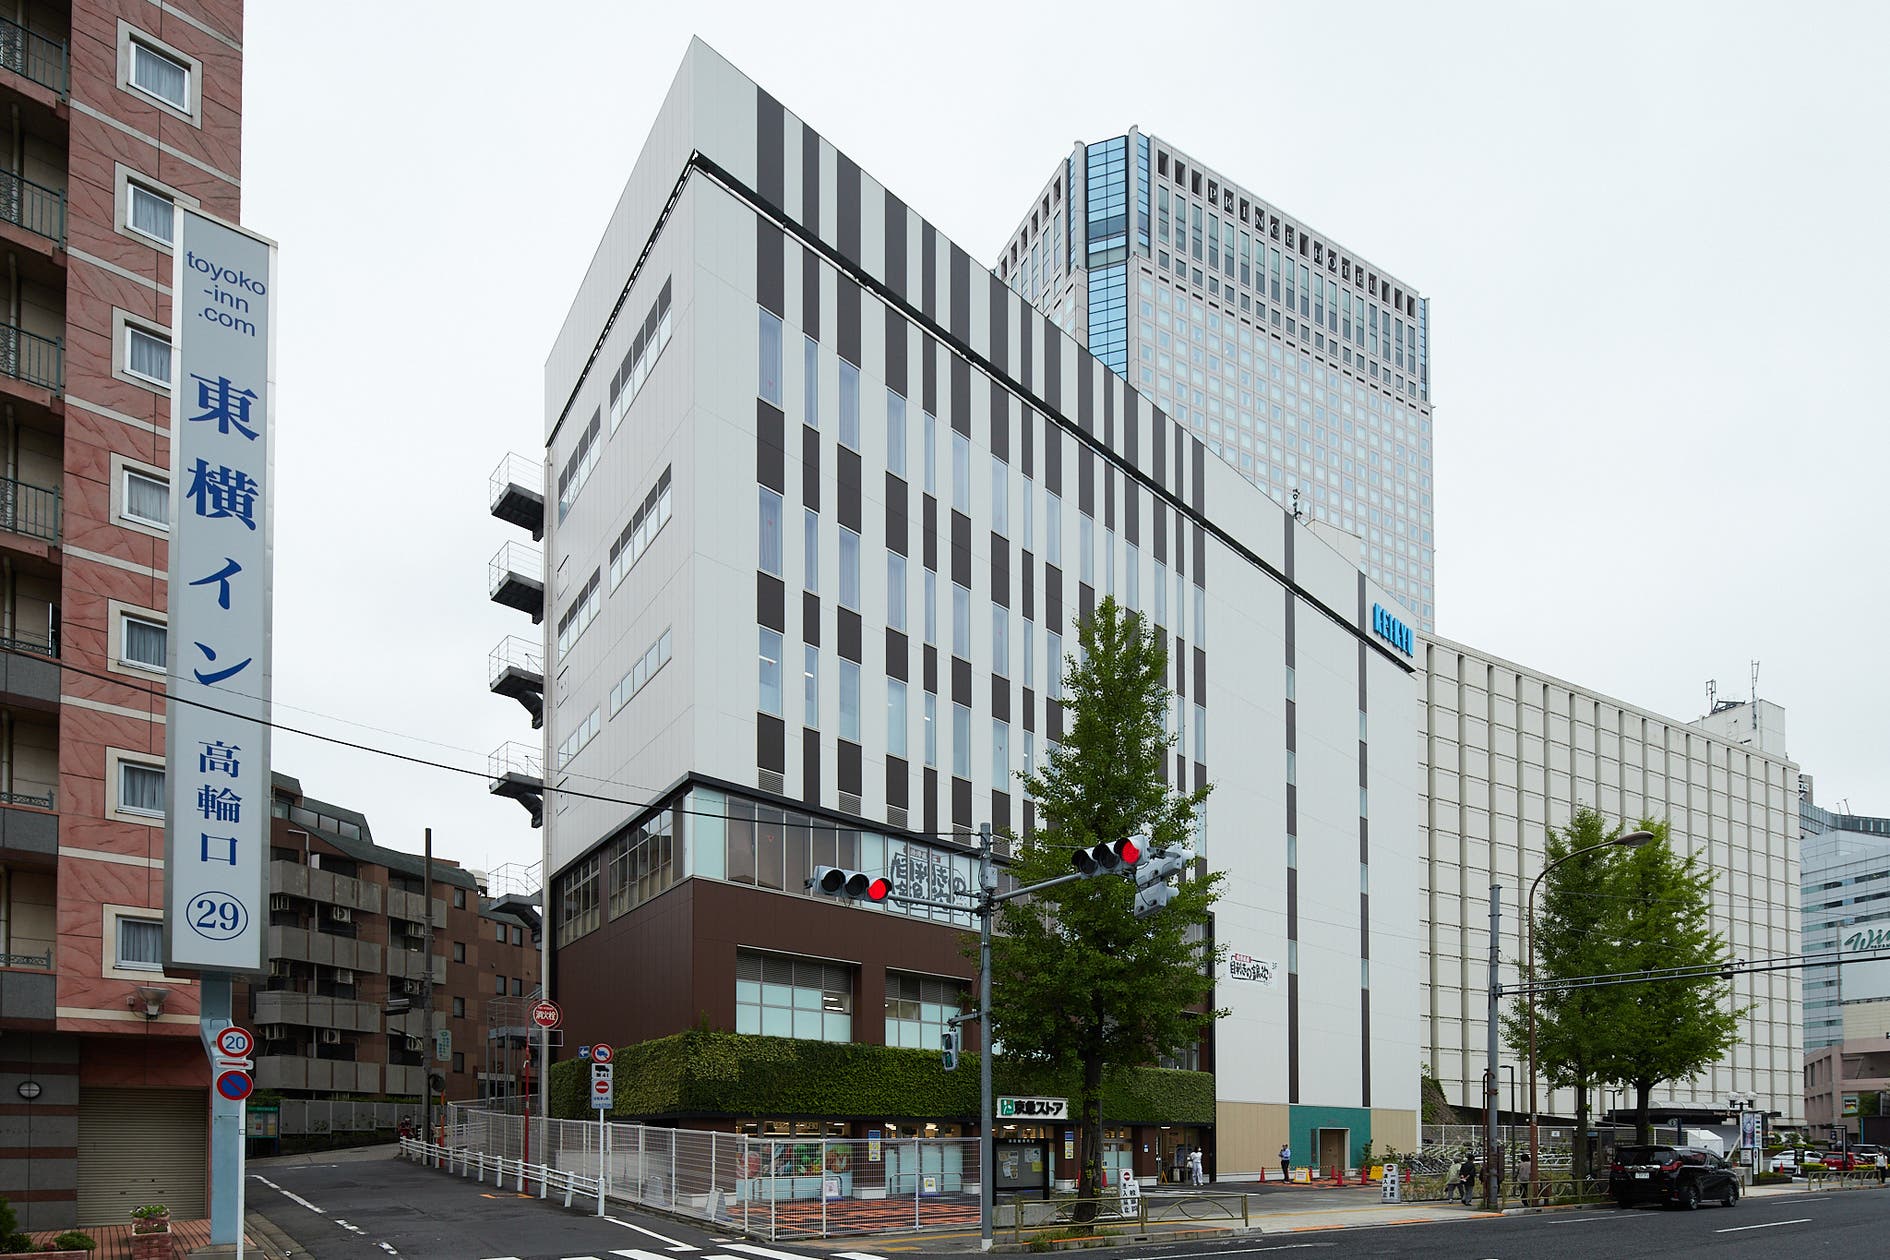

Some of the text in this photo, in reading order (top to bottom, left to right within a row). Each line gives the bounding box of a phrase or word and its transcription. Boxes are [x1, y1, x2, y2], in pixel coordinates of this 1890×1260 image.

[1210, 187, 1375, 292] PRINCE HOTEL
[187, 250, 266, 296] toyoko
[203, 284, 249, 314] -inn
[198, 306, 256, 337] .com
[185, 372, 260, 686] 東横イン
[196, 740, 242, 866] 高輪口
[196, 899, 239, 931] 29
[225, 1035, 246, 1050] 20
